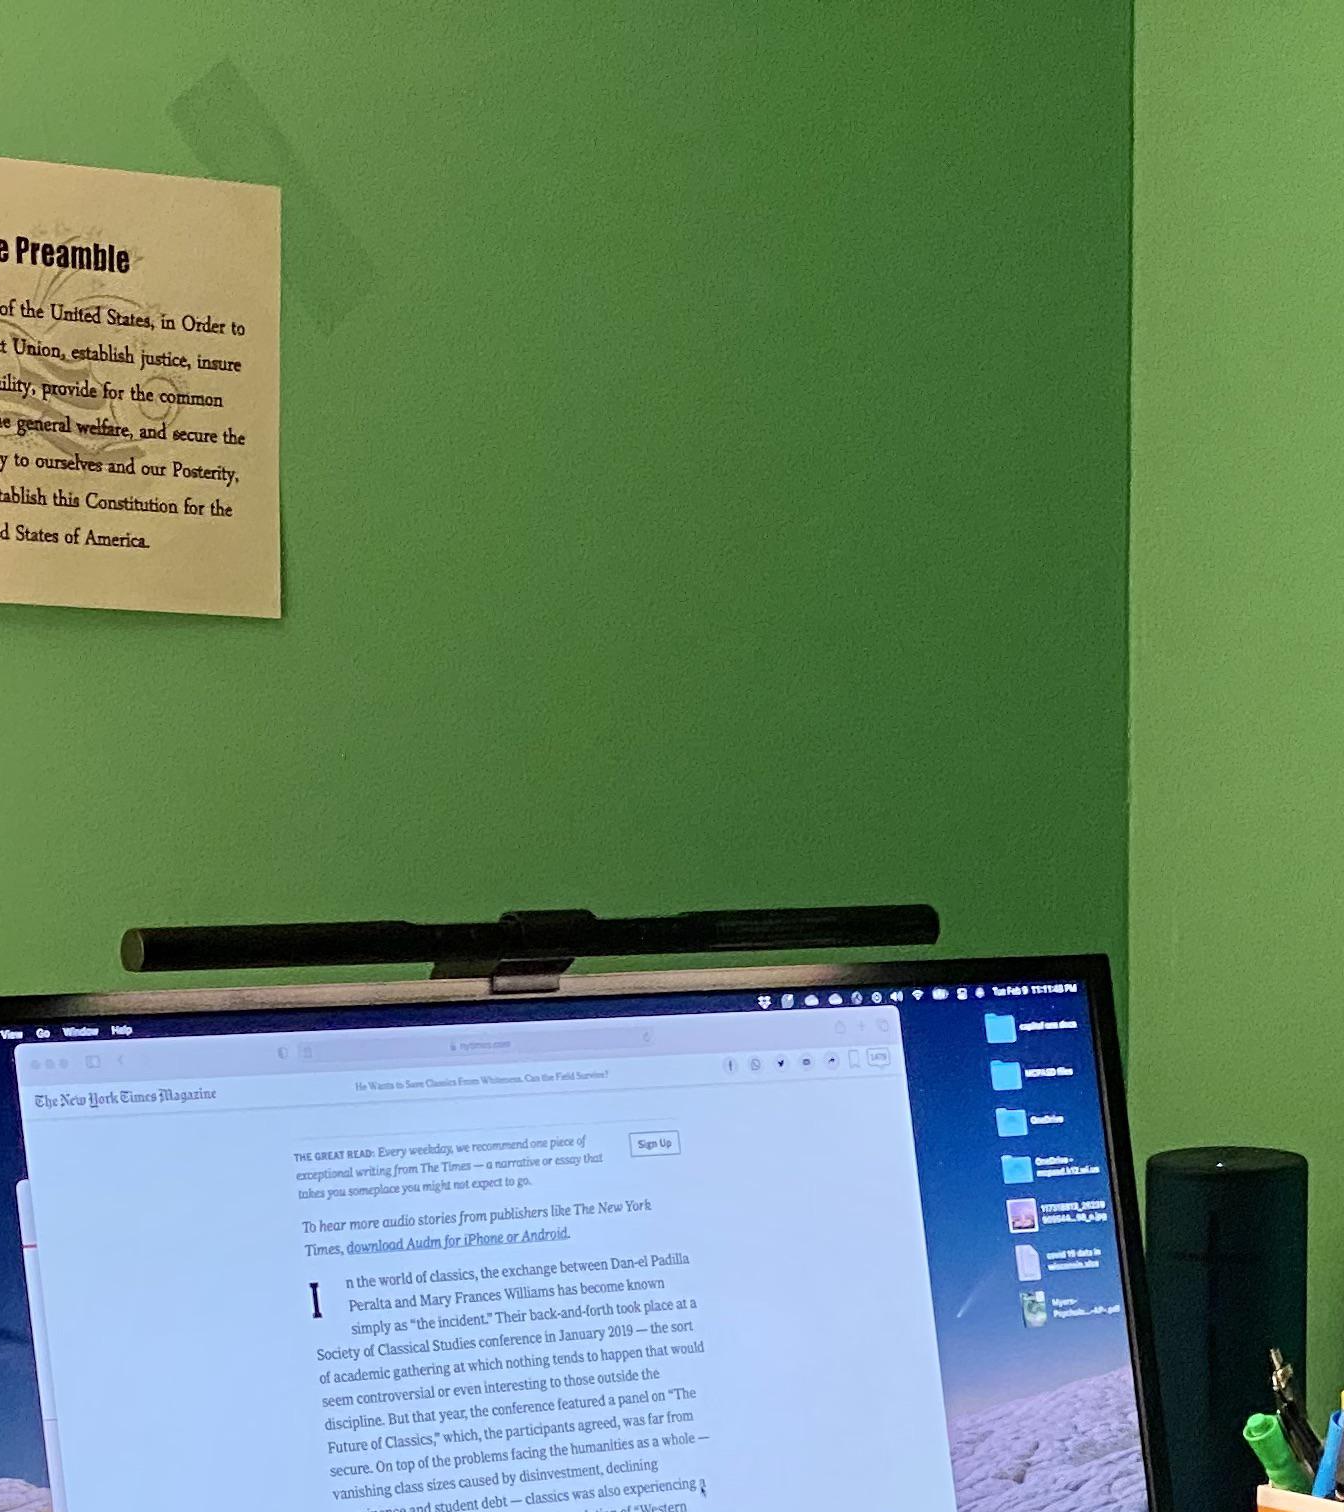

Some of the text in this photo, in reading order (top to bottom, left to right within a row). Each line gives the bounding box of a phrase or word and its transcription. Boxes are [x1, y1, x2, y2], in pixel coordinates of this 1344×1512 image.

[15, 235, 130, 274] Preamble
[20, 299, 44, 319] the
[49, 303, 102, 324] United
[106, 308, 155, 331] States,
[160, 313, 176, 330] in
[181, 314, 226, 334] Order
[231, 321, 245, 336] to
[12, 337, 65, 361] Union,
[71, 343, 134, 364] establish
[140, 350, 191, 371] justice,
[197, 355, 241, 372] insure
[40, 378, 98, 403] provide
[102, 381, 125, 400] for
[130, 383, 154, 402] the
[158, 387, 224, 409] common
[16, 412, 72, 437] general
[75, 417, 134, 441] welfare,
[139, 421, 167, 441] and
[172, 429, 218, 443] secure
[222, 427, 245, 445] the
[13, 452, 29, 467] to
[35, 452, 104, 472] ourselves
[107, 456, 136, 475] and
[140, 464, 167, 476] our
[172, 460, 239, 487] Posterity,
[52, 488, 79, 508] this
[85, 492, 178, 513] Constitution
[184, 497, 205, 515] for
[210, 498, 232, 517] the
[15, 524, 59, 543] States
[64, 526, 81, 545] of
[84, 529, 150, 549] America.
[0, 1029, 23, 1040] View
[35, 1028, 51, 1039] Go
[34, 1087, 216, 1110] The New York Times Magazine
[638, 1138, 672, 1150] Sign Up
[300, 1198, 653, 1234] To hear more audio stories from publishers like The New York
[346, 1236, 404, 1254] download
[406, 1234, 442, 1248] Audm
[442, 1232, 462, 1250] for
[464, 1230, 504, 1246] iPhone
[506, 1232, 520, 1242] or
[344, 1251, 690, 1289] n the world of classics, the exchange between Dan-el Padilla
